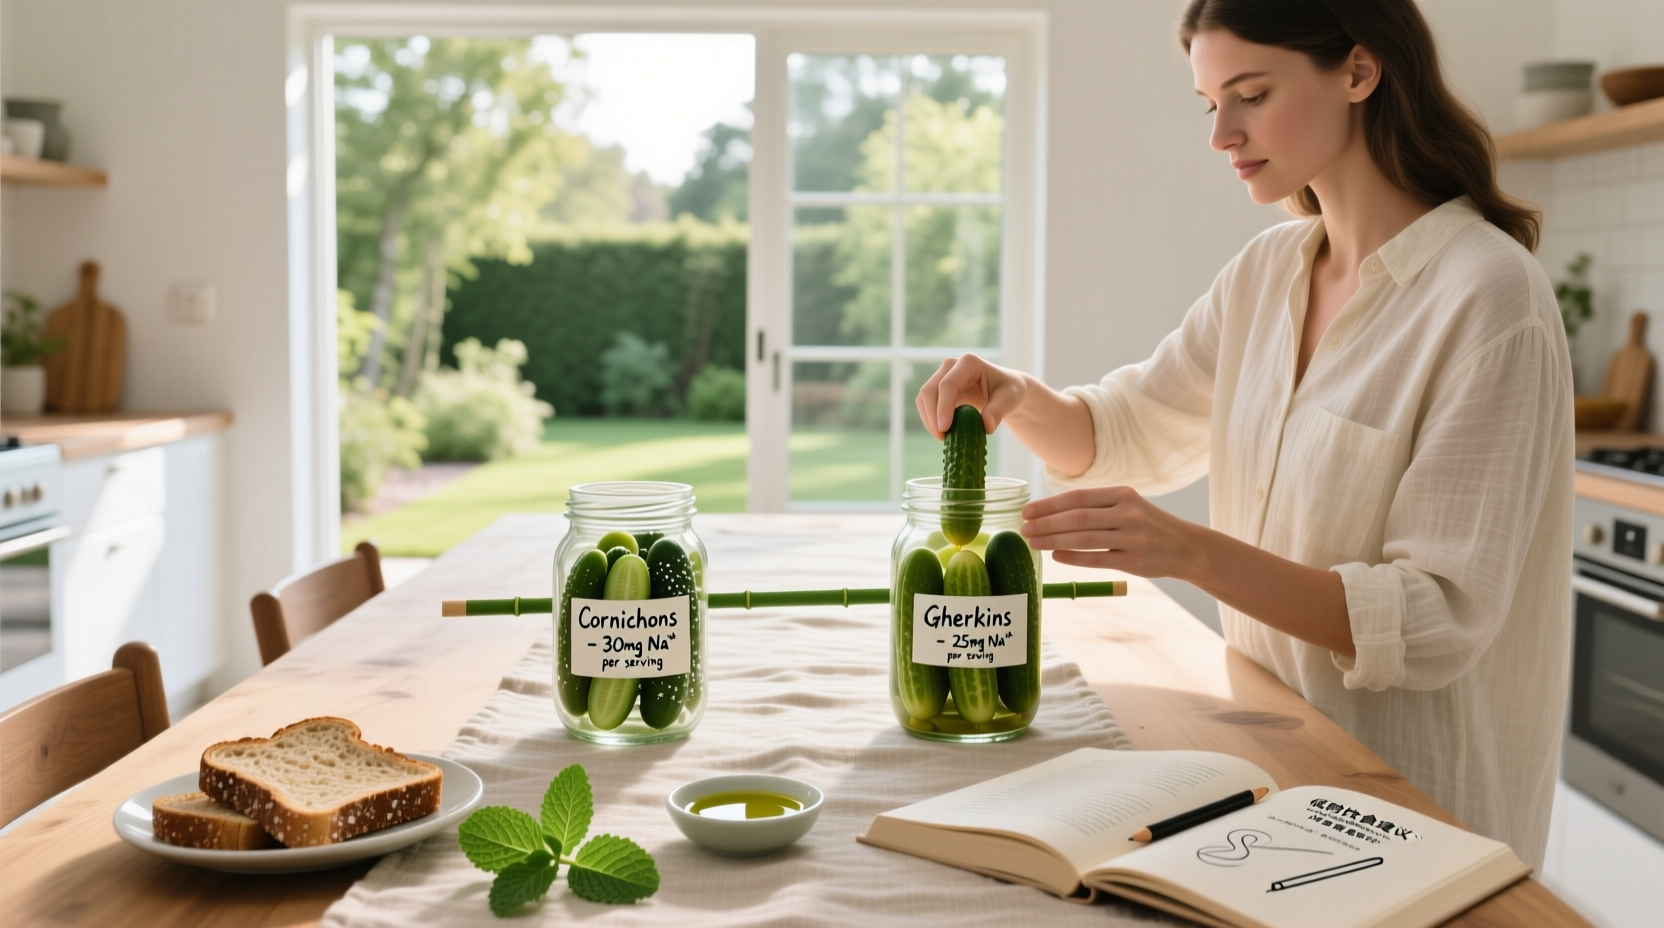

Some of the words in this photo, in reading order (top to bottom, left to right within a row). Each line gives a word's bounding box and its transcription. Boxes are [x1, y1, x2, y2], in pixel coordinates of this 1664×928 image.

[578, 605, 678, 629] Cornichons
[923, 604, 1012, 629] Gherkins
[602, 635, 643, 658] 30mg
[952, 634, 985, 652] 25mg
[601, 658, 620, 673] per
[625, 656, 663, 672] serving
